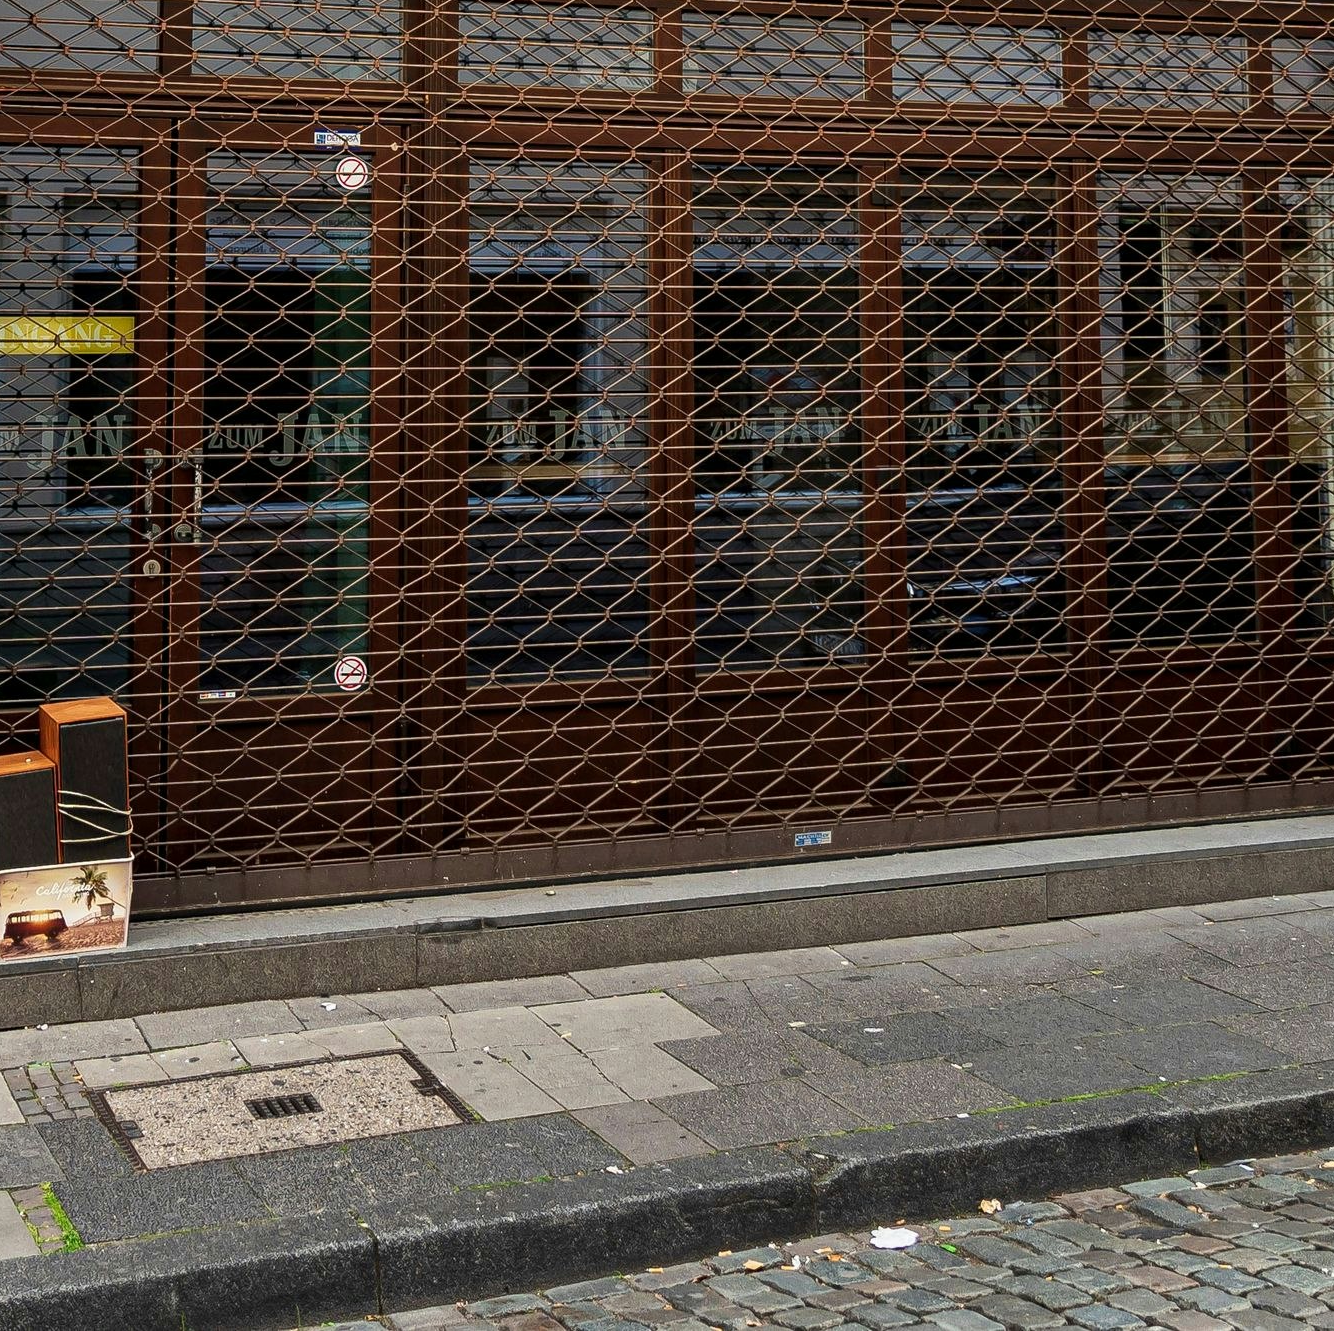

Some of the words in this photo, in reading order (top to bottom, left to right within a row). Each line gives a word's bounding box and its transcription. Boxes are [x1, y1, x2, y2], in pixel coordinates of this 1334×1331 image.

[26, 414, 126, 470] JAN
[208, 423, 265, 450] ZUM
[268, 412, 363, 467] JAN
[486, 420, 538, 446] ZUM
[548, 408, 628, 463] JAN
[767, 406, 848, 459] JAN
[35, 881, 97, 901] California
